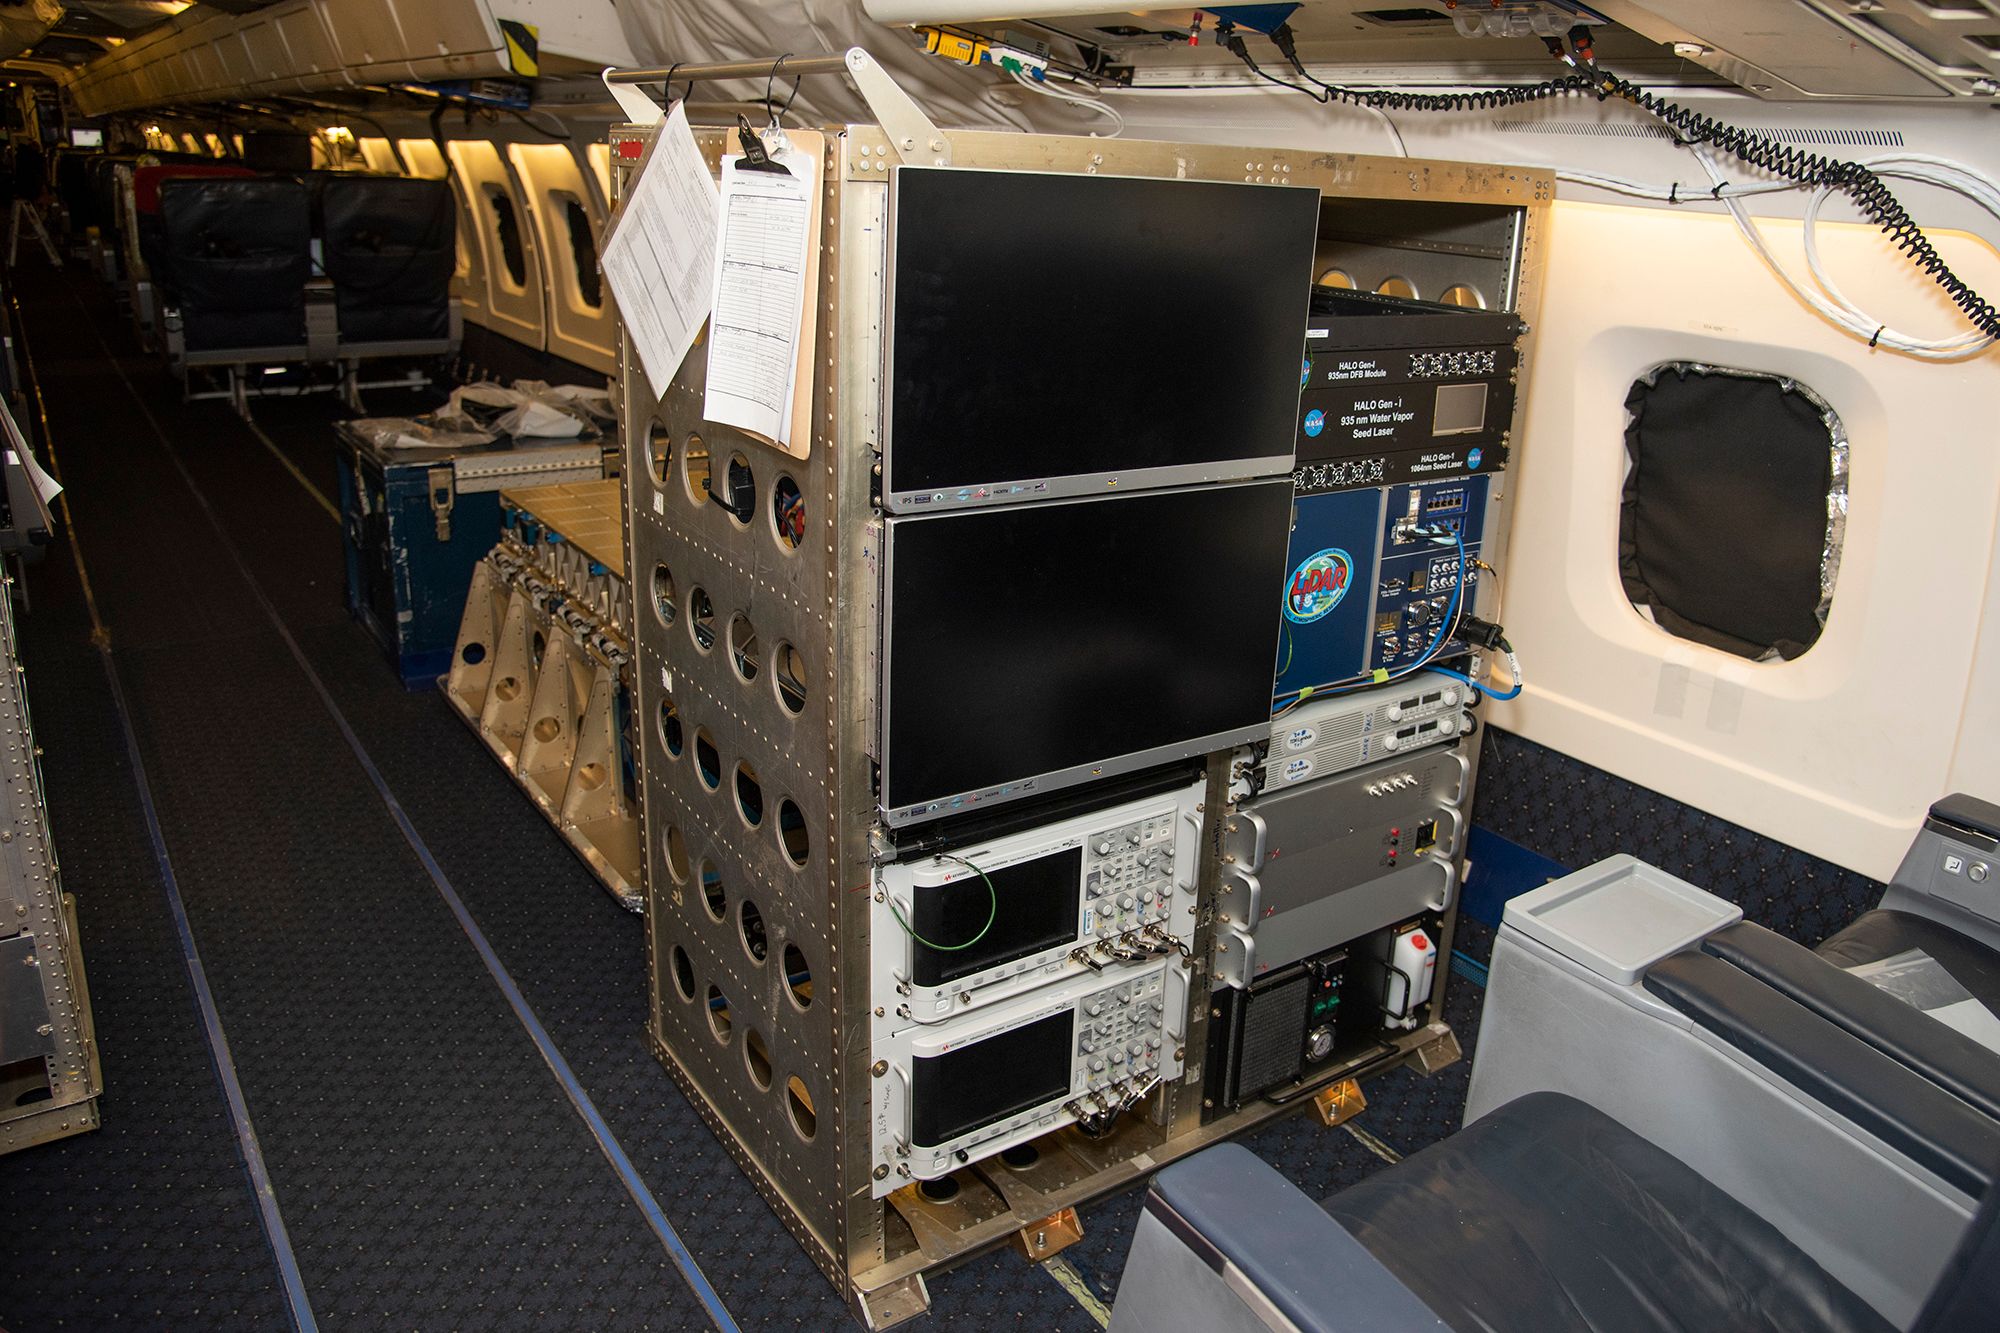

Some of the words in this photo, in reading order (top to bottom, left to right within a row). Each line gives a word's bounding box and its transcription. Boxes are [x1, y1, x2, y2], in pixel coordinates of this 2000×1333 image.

[1338, 361, 1358, 370] HALO
[1327, 371, 1349, 380] 935nm
[1350, 370, 1364, 379] DFB
[1364, 369, 1387, 378] Module
[1353, 400, 1377, 411] HALO
[1378, 399, 1393, 409] Gen
[1305, 419, 1324, 428] NASA
[1340, 415, 1355, 426] 935
[1356, 415, 1368, 425] nm
[1369, 413, 1391, 424] Water
[1392, 411, 1415, 423] Vapor
[1352, 427, 1372, 439] Seed
[1373, 427, 1395, 437] Laser
[1420, 453, 1438, 463] HALO
[1410, 464, 1432, 473] 1064nm
[1433, 461, 1447, 470] Seed
[1448, 460, 1463, 469] Laser
